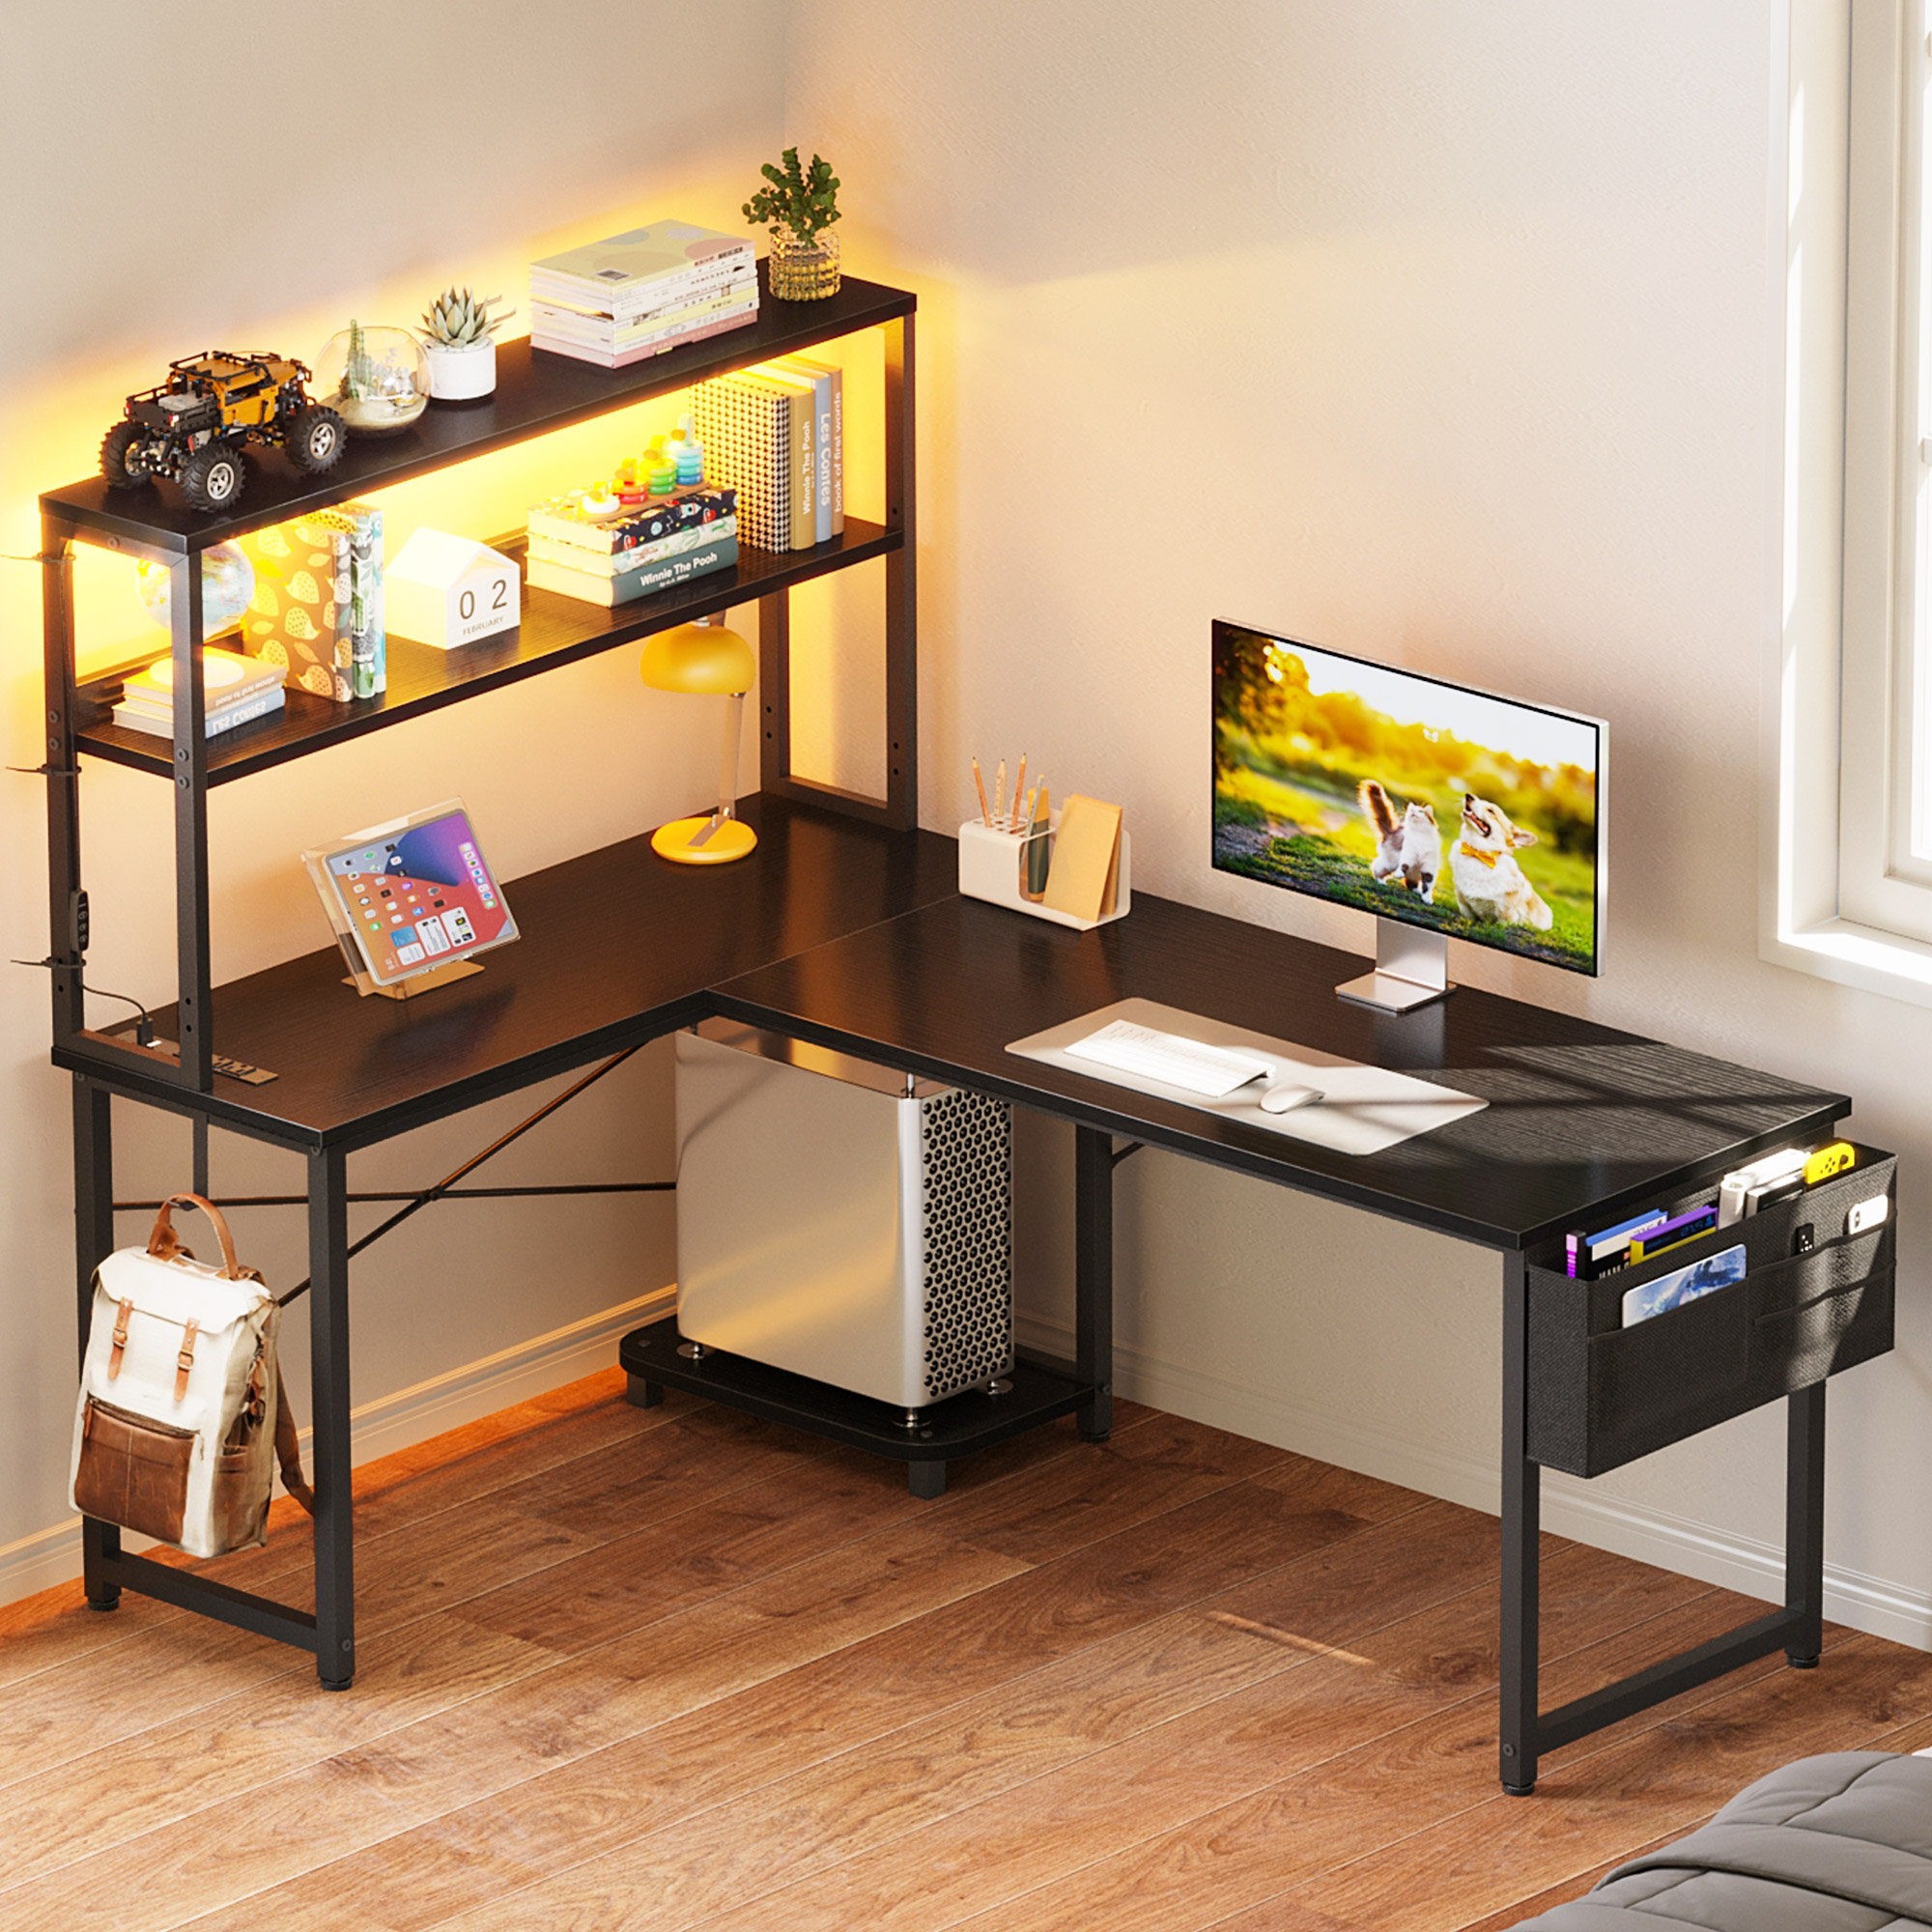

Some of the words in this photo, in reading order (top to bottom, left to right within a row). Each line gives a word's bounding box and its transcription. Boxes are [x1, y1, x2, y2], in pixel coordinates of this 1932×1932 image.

[802, 420, 810, 450] Pooh
[820, 412, 831, 443] Les
[802, 452, 810, 474] The
[820, 447, 831, 506] Contes
[803, 476, 811, 515] Winnie
[639, 568, 672, 586] Winnie
[673, 562, 692, 575] The
[693, 552, 718, 569] Pooh
[463, 617, 503, 635] FEBRUARY
